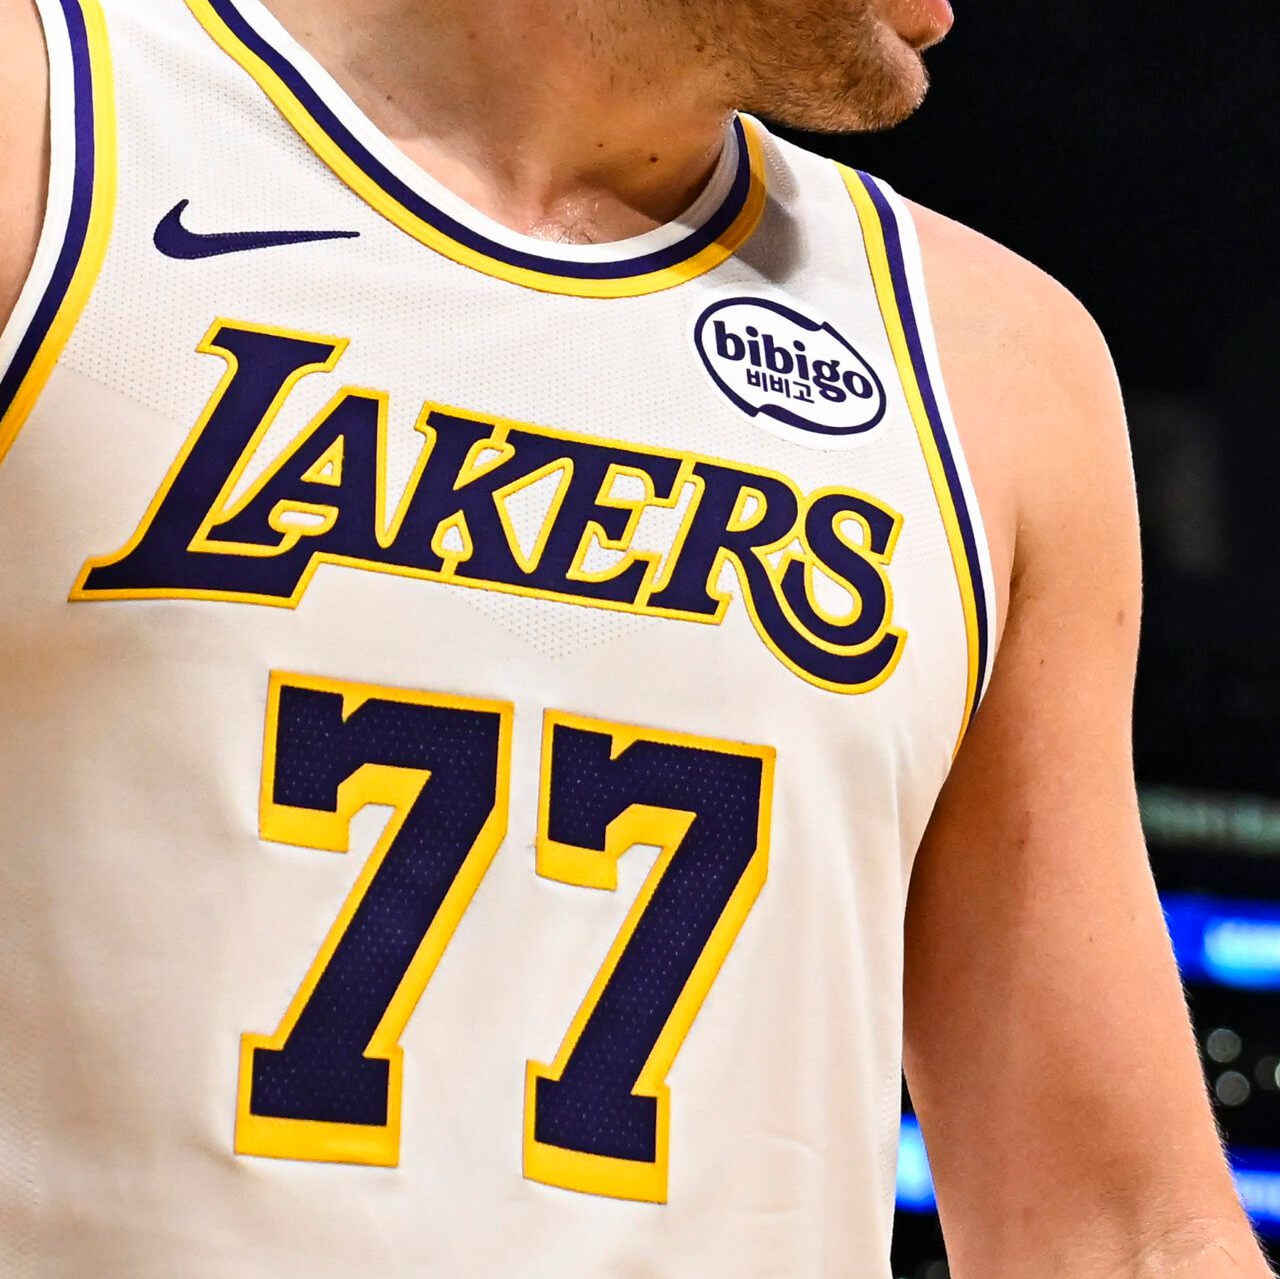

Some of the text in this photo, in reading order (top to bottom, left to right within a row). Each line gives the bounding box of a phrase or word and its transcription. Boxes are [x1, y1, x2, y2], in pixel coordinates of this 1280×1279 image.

[713, 320, 874, 403] bibigo
[745, 368, 815, 404] 비비고
[68, 317, 908, 695] LAKERS
[234, 668, 776, 1205] 77
